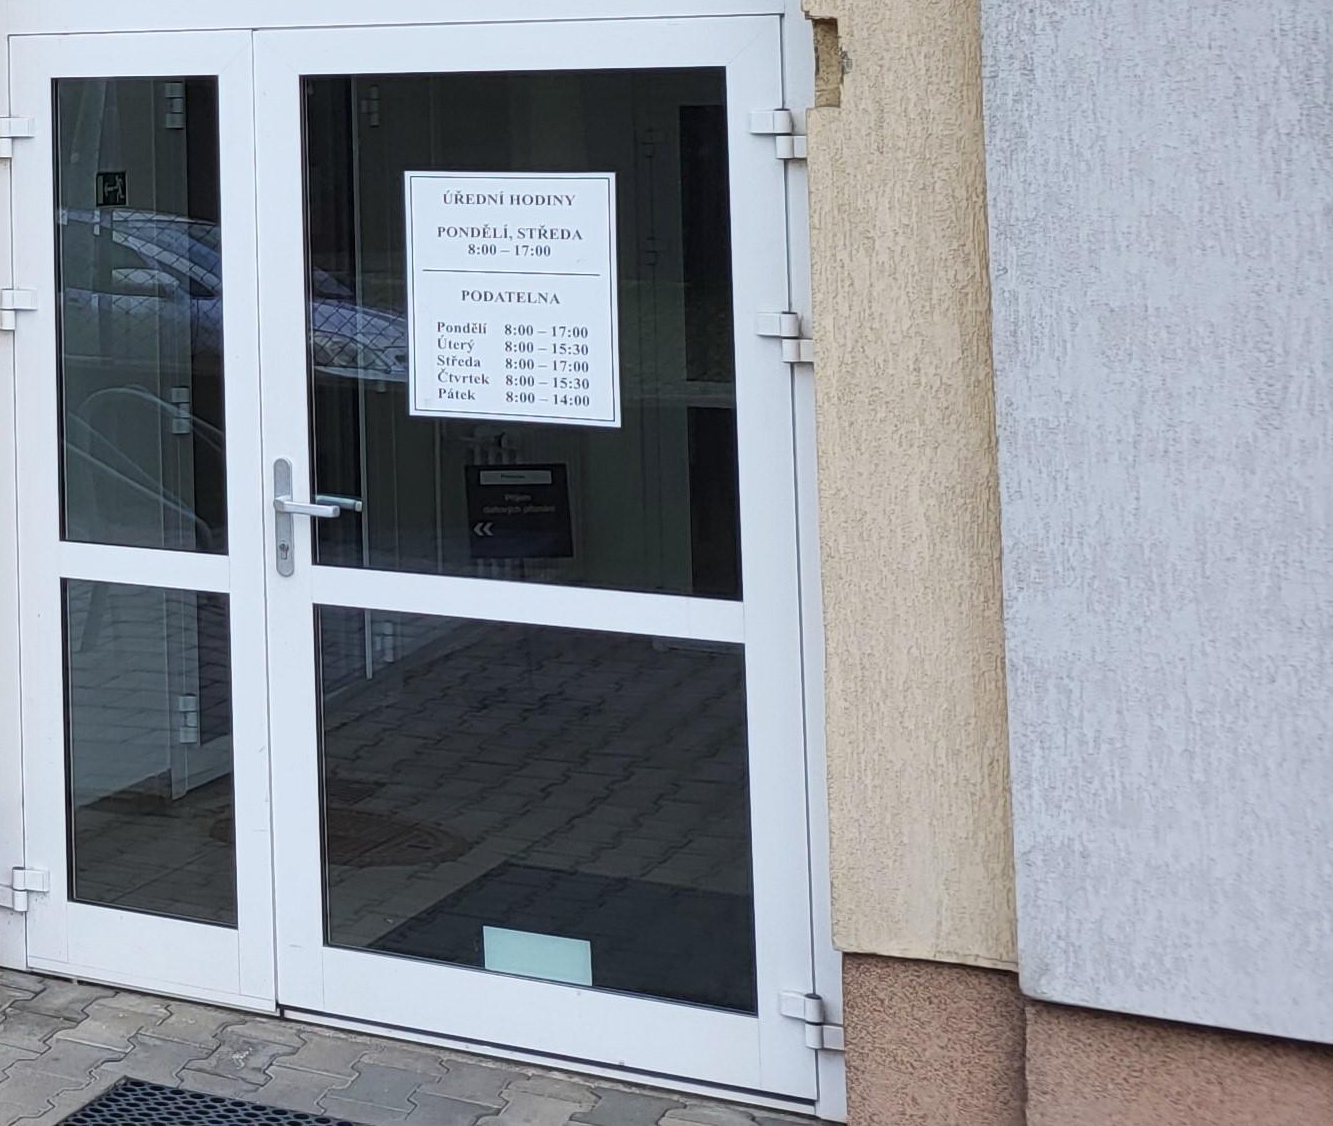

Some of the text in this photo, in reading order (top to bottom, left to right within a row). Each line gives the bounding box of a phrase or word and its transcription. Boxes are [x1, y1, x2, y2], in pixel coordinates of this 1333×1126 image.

[443, 190, 576, 206] ÚŘEDNÍ HODINY
[437, 224, 583, 240] PONDĚLÍ, STŘEDA
[468, 243, 497, 255] 8:00
[515, 244, 551, 257] 17:00
[461, 289, 560, 305] PODATELNA
[437, 321, 487, 335] Pondělí
[504, 324, 534, 336] 8:00
[552, 325, 589, 339] 17:00
[437, 335, 475, 353] Úterý
[504, 341, 534, 353] 8:00
[552, 343, 589, 356] 15:30
[436, 355, 481, 368] Středa
[505, 358, 535, 370] 8:00
[553, 360, 589, 373] 17:00
[437, 368, 490, 385] Čtvrtek
[505, 374, 535, 387] 8:00
[553, 377, 590, 390] 15:30
[438, 387, 476, 400] Pátek
[505, 391, 536, 404] 8:00
[554, 393, 590, 406] 14:00
